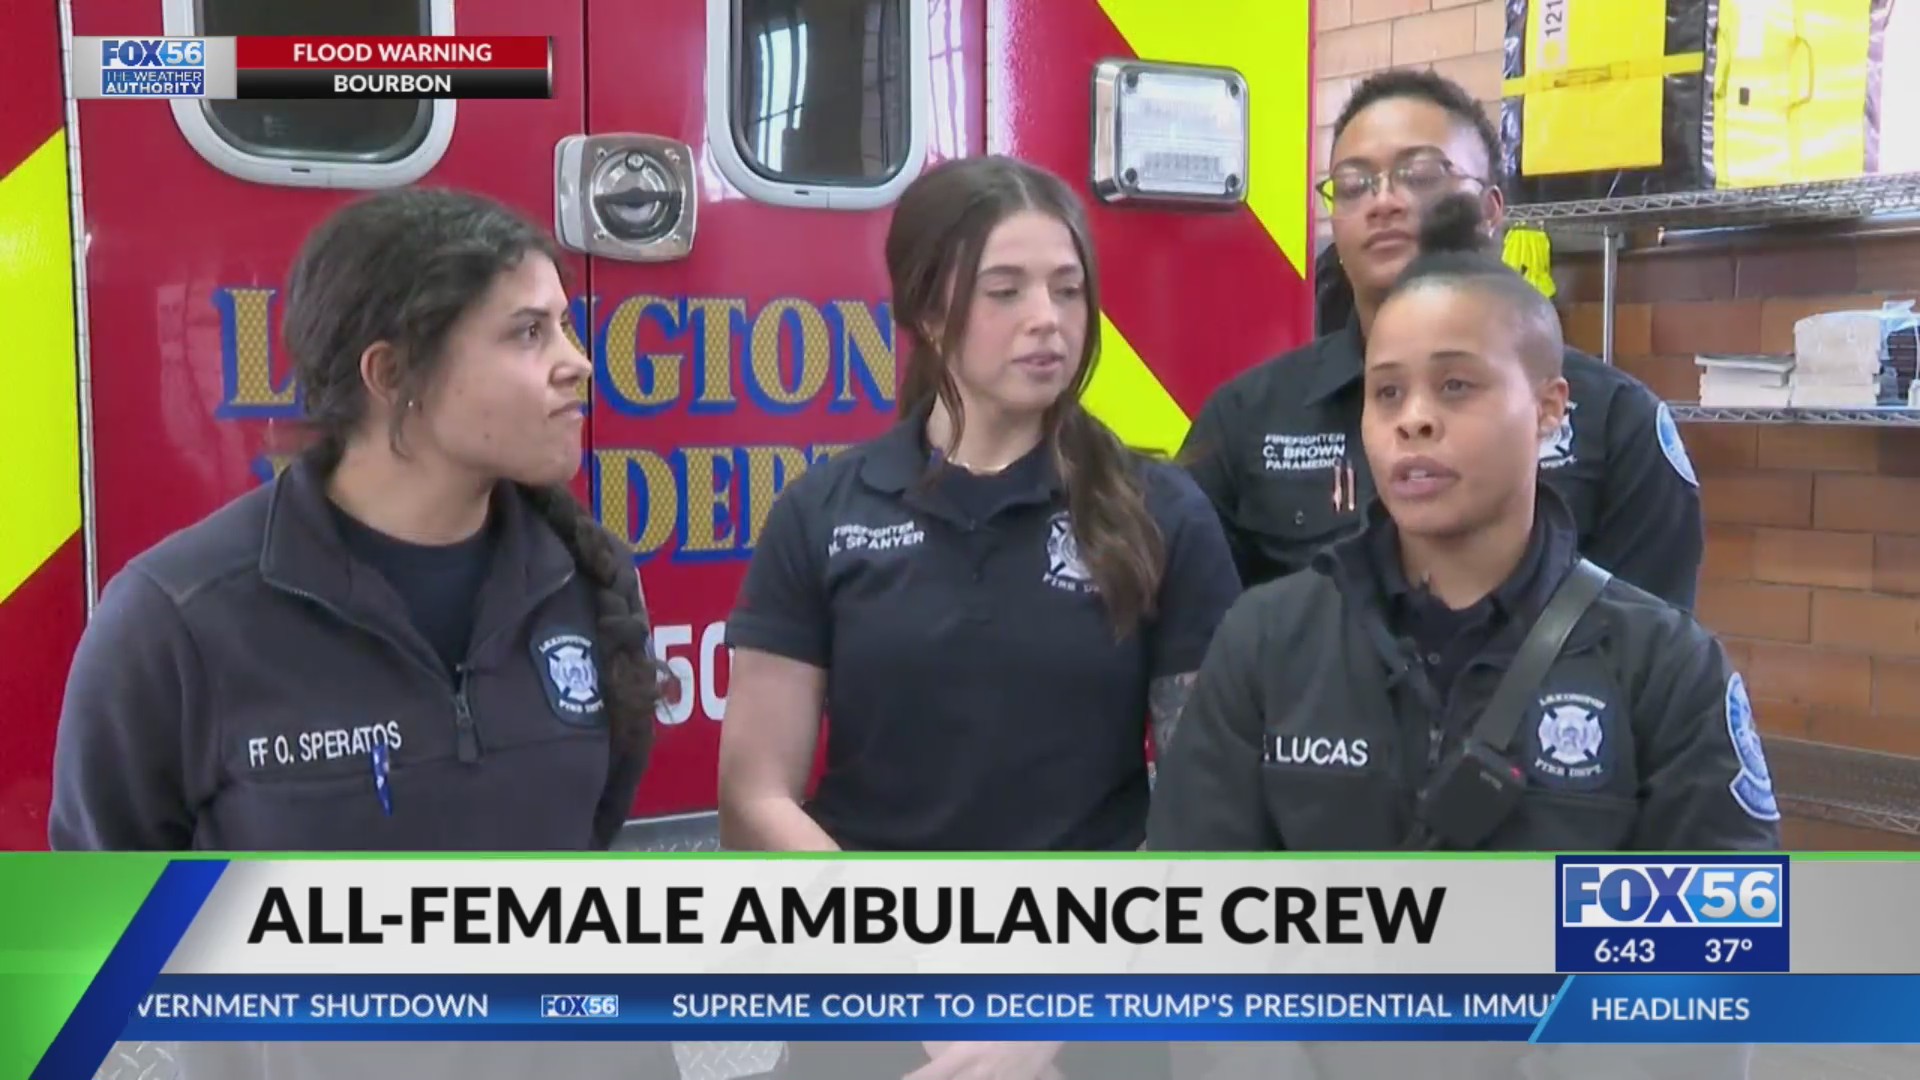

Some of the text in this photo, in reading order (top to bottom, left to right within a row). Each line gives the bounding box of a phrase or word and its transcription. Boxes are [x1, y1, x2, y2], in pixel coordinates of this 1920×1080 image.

[1262, 444, 1345, 459] C. BROWN
[593, 445, 852, 563] DEP
[846, 531, 925, 550] SPANYER
[249, 720, 402, 767] FF O. SPERATOS
[1276, 736, 1368, 766] LUCAS
